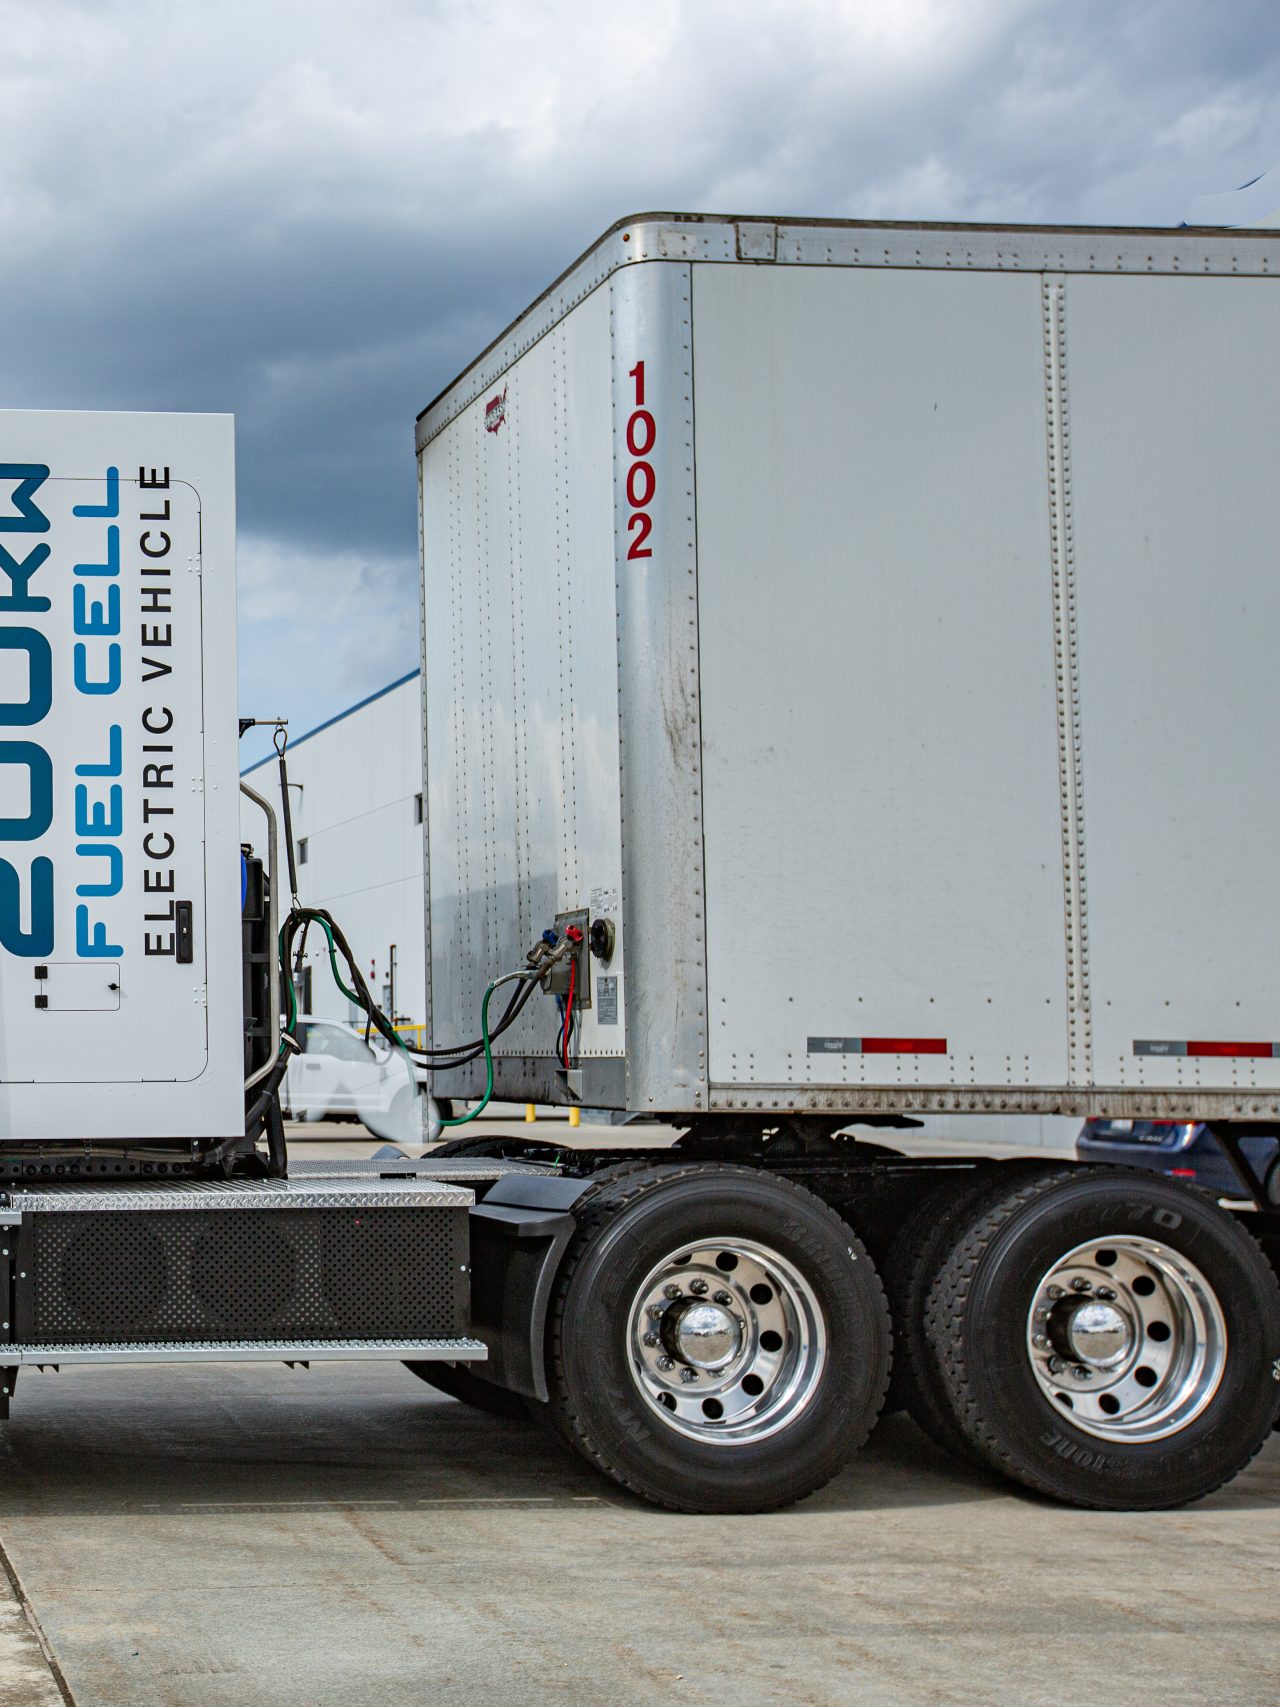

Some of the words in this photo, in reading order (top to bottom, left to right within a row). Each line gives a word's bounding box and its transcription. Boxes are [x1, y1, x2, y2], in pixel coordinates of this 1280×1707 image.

[139, 466, 173, 682] VEHICLE
[625, 360, 657, 561] 1002
[72, 466, 122, 695] CELL
[75, 724, 124, 958] FUEL
[142, 706, 176, 956] ELECTRIC
